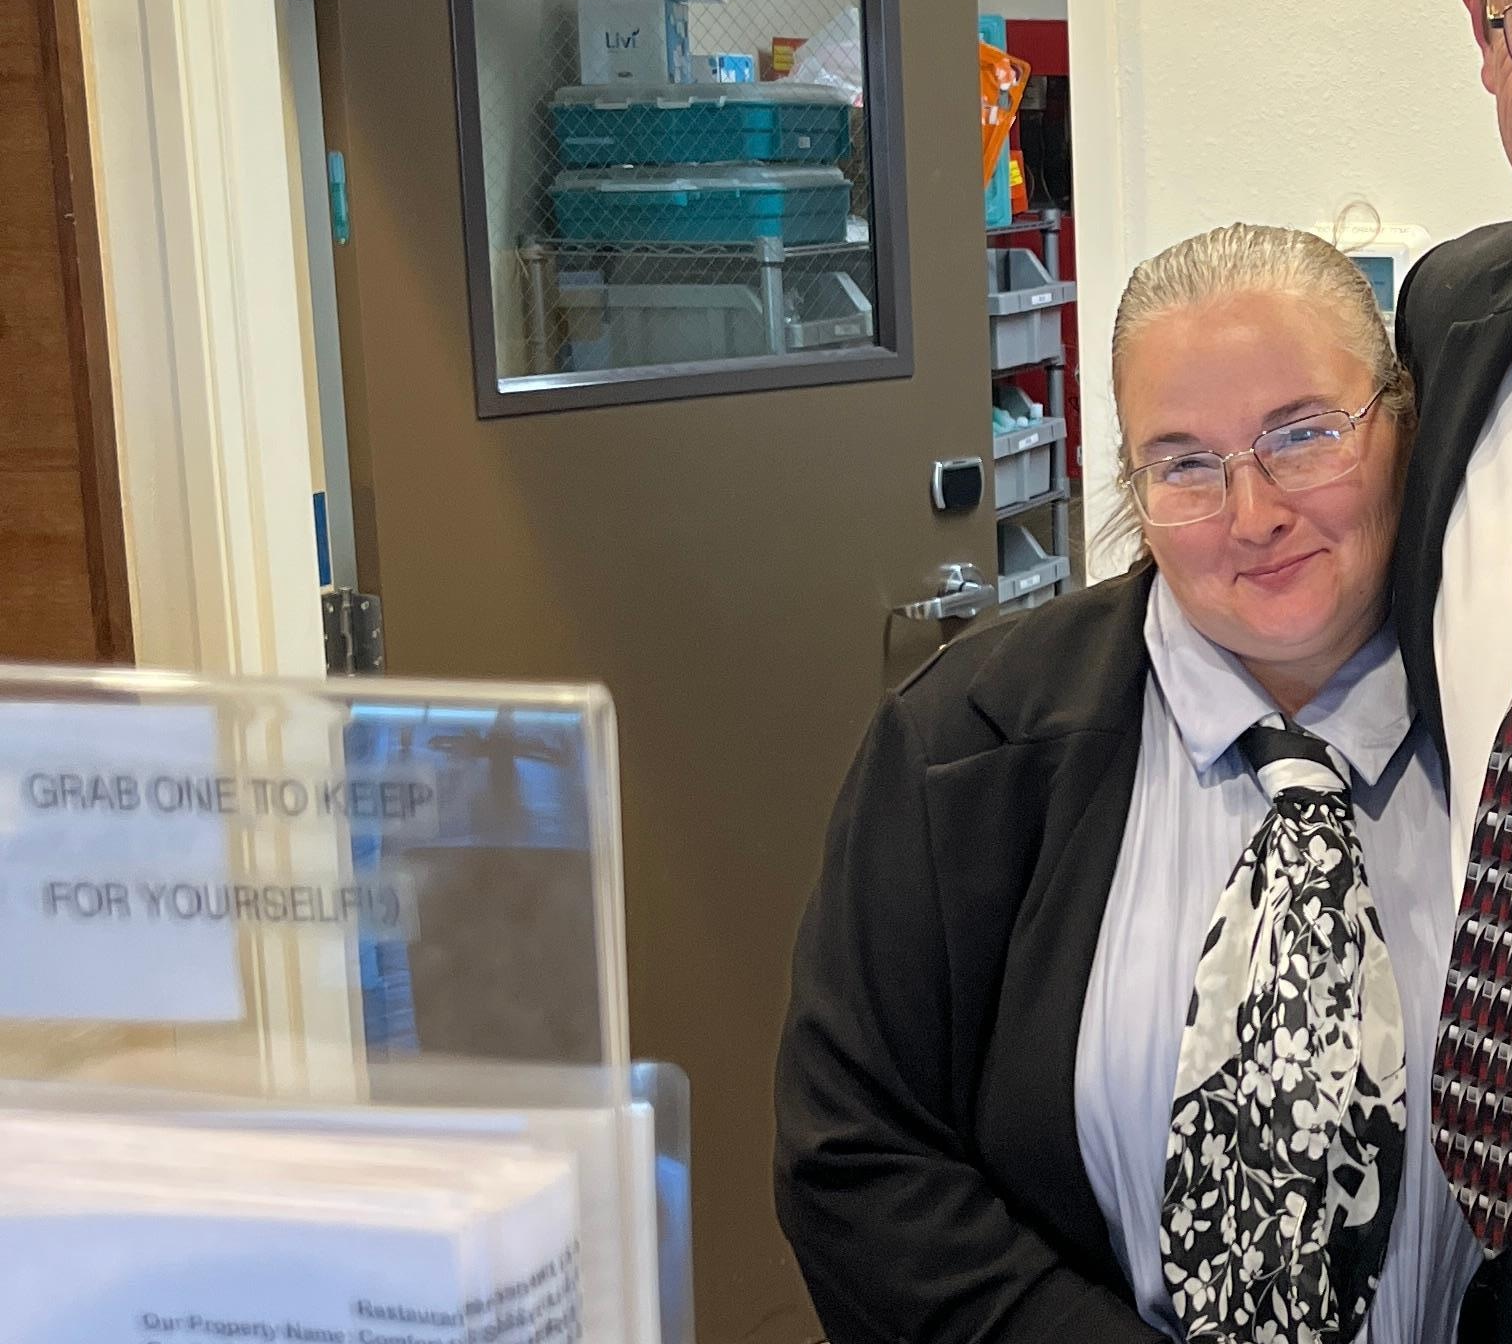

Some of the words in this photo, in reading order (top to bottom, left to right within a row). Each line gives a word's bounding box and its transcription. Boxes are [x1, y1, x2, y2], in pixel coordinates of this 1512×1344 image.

[605, 28, 640, 49] Livi
[27, 772, 138, 810] GRAB
[153, 775, 235, 814] ONE
[250, 777, 308, 817] TO
[322, 779, 435, 820] KEEP
[46, 881, 131, 917] FOR
[141, 1312, 185, 1332] Our
[190, 1315, 276, 1344] Property
